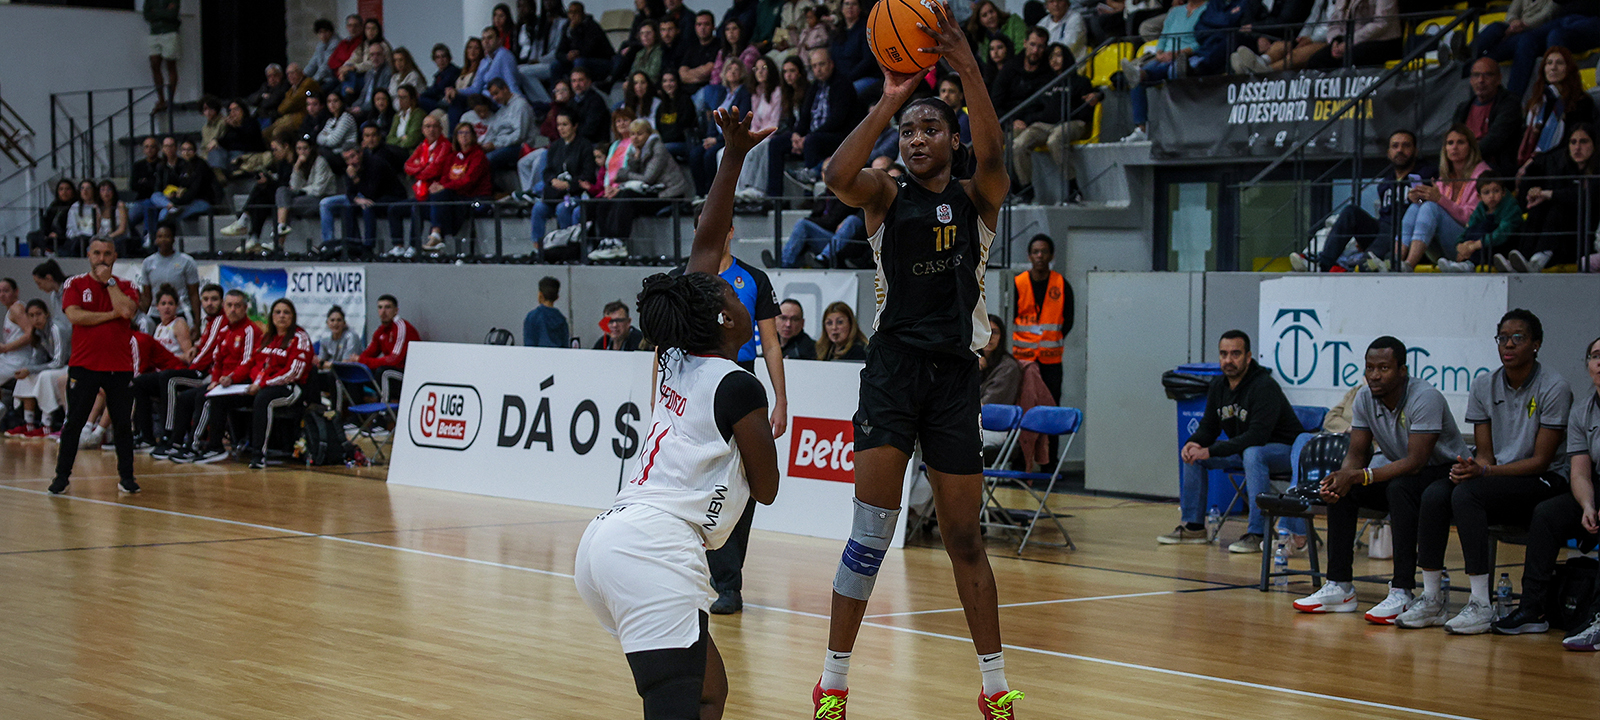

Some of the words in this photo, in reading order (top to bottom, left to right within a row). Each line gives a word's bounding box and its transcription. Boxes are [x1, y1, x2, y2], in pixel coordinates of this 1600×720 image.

[888, 46, 903, 63] FIBA
[1227, 83, 1237, 104] O
[1237, 77, 1286, 102] ASSÉDIO
[1228, 104, 1248, 124] NO
[1247, 100, 1309, 123] DESPORTO.
[933, 225, 957, 252] 10
[291, 272, 313, 293] SCT
[317, 272, 362, 293] POWER
[497, 374, 554, 452] DÁ
[570, 399, 600, 455] O
[438, 422, 464, 437] Betclic
[795, 429, 854, 472] Betc
[702, 484, 728, 532] MBW
